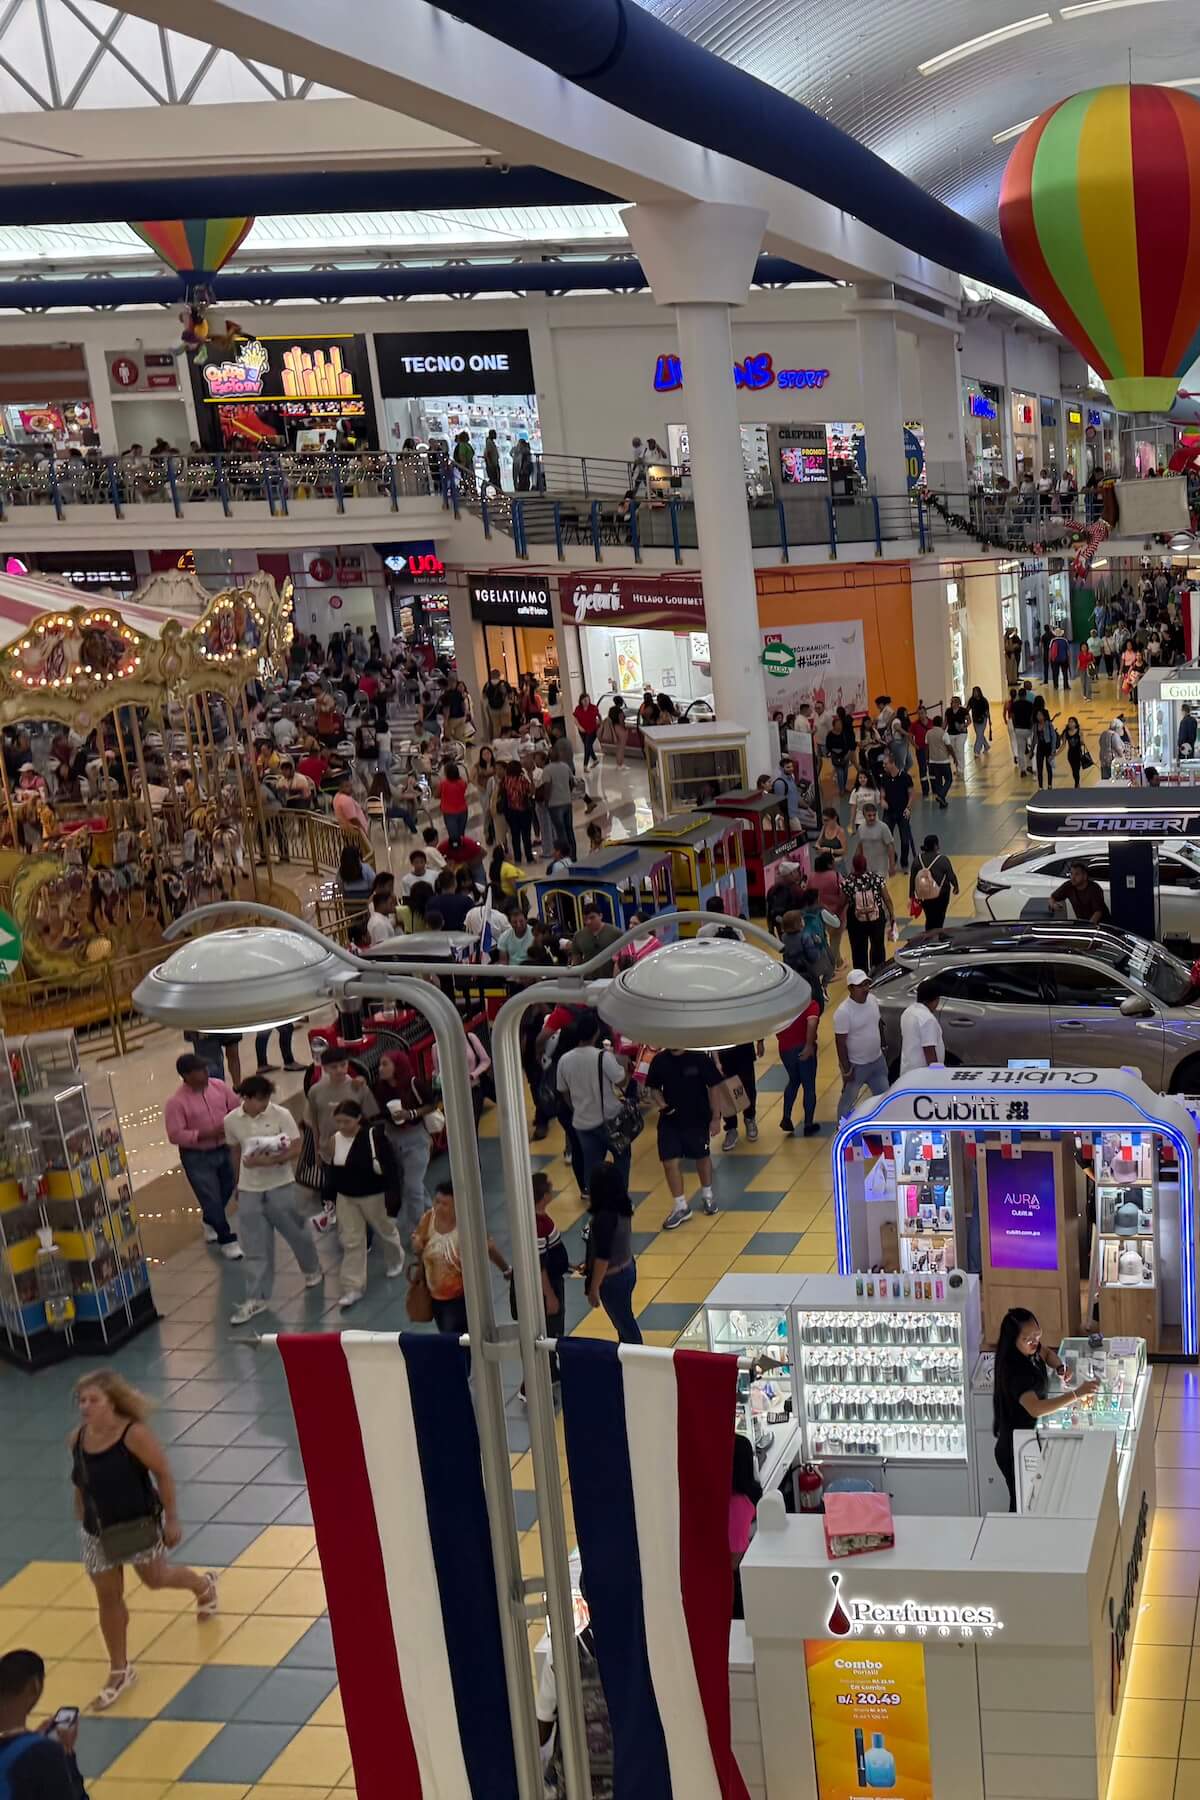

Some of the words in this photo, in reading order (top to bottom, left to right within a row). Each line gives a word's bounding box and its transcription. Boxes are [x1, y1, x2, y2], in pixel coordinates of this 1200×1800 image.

[401, 356, 465, 373] TECNO
[469, 354, 510, 371] ONE
[480, 589, 548, 604] GELATIAMO
[1057, 814, 1200, 832] SCHUBERT
[987, 1071, 1098, 1084] Cubitt
[913, 1095, 1000, 1121] Cubitt
[1004, 1193, 1041, 1205] AURA
[852, 1602, 993, 1624] Perfumes
[834, 1658, 883, 1669] Combo
[857, 1692, 901, 1705] 20.49
